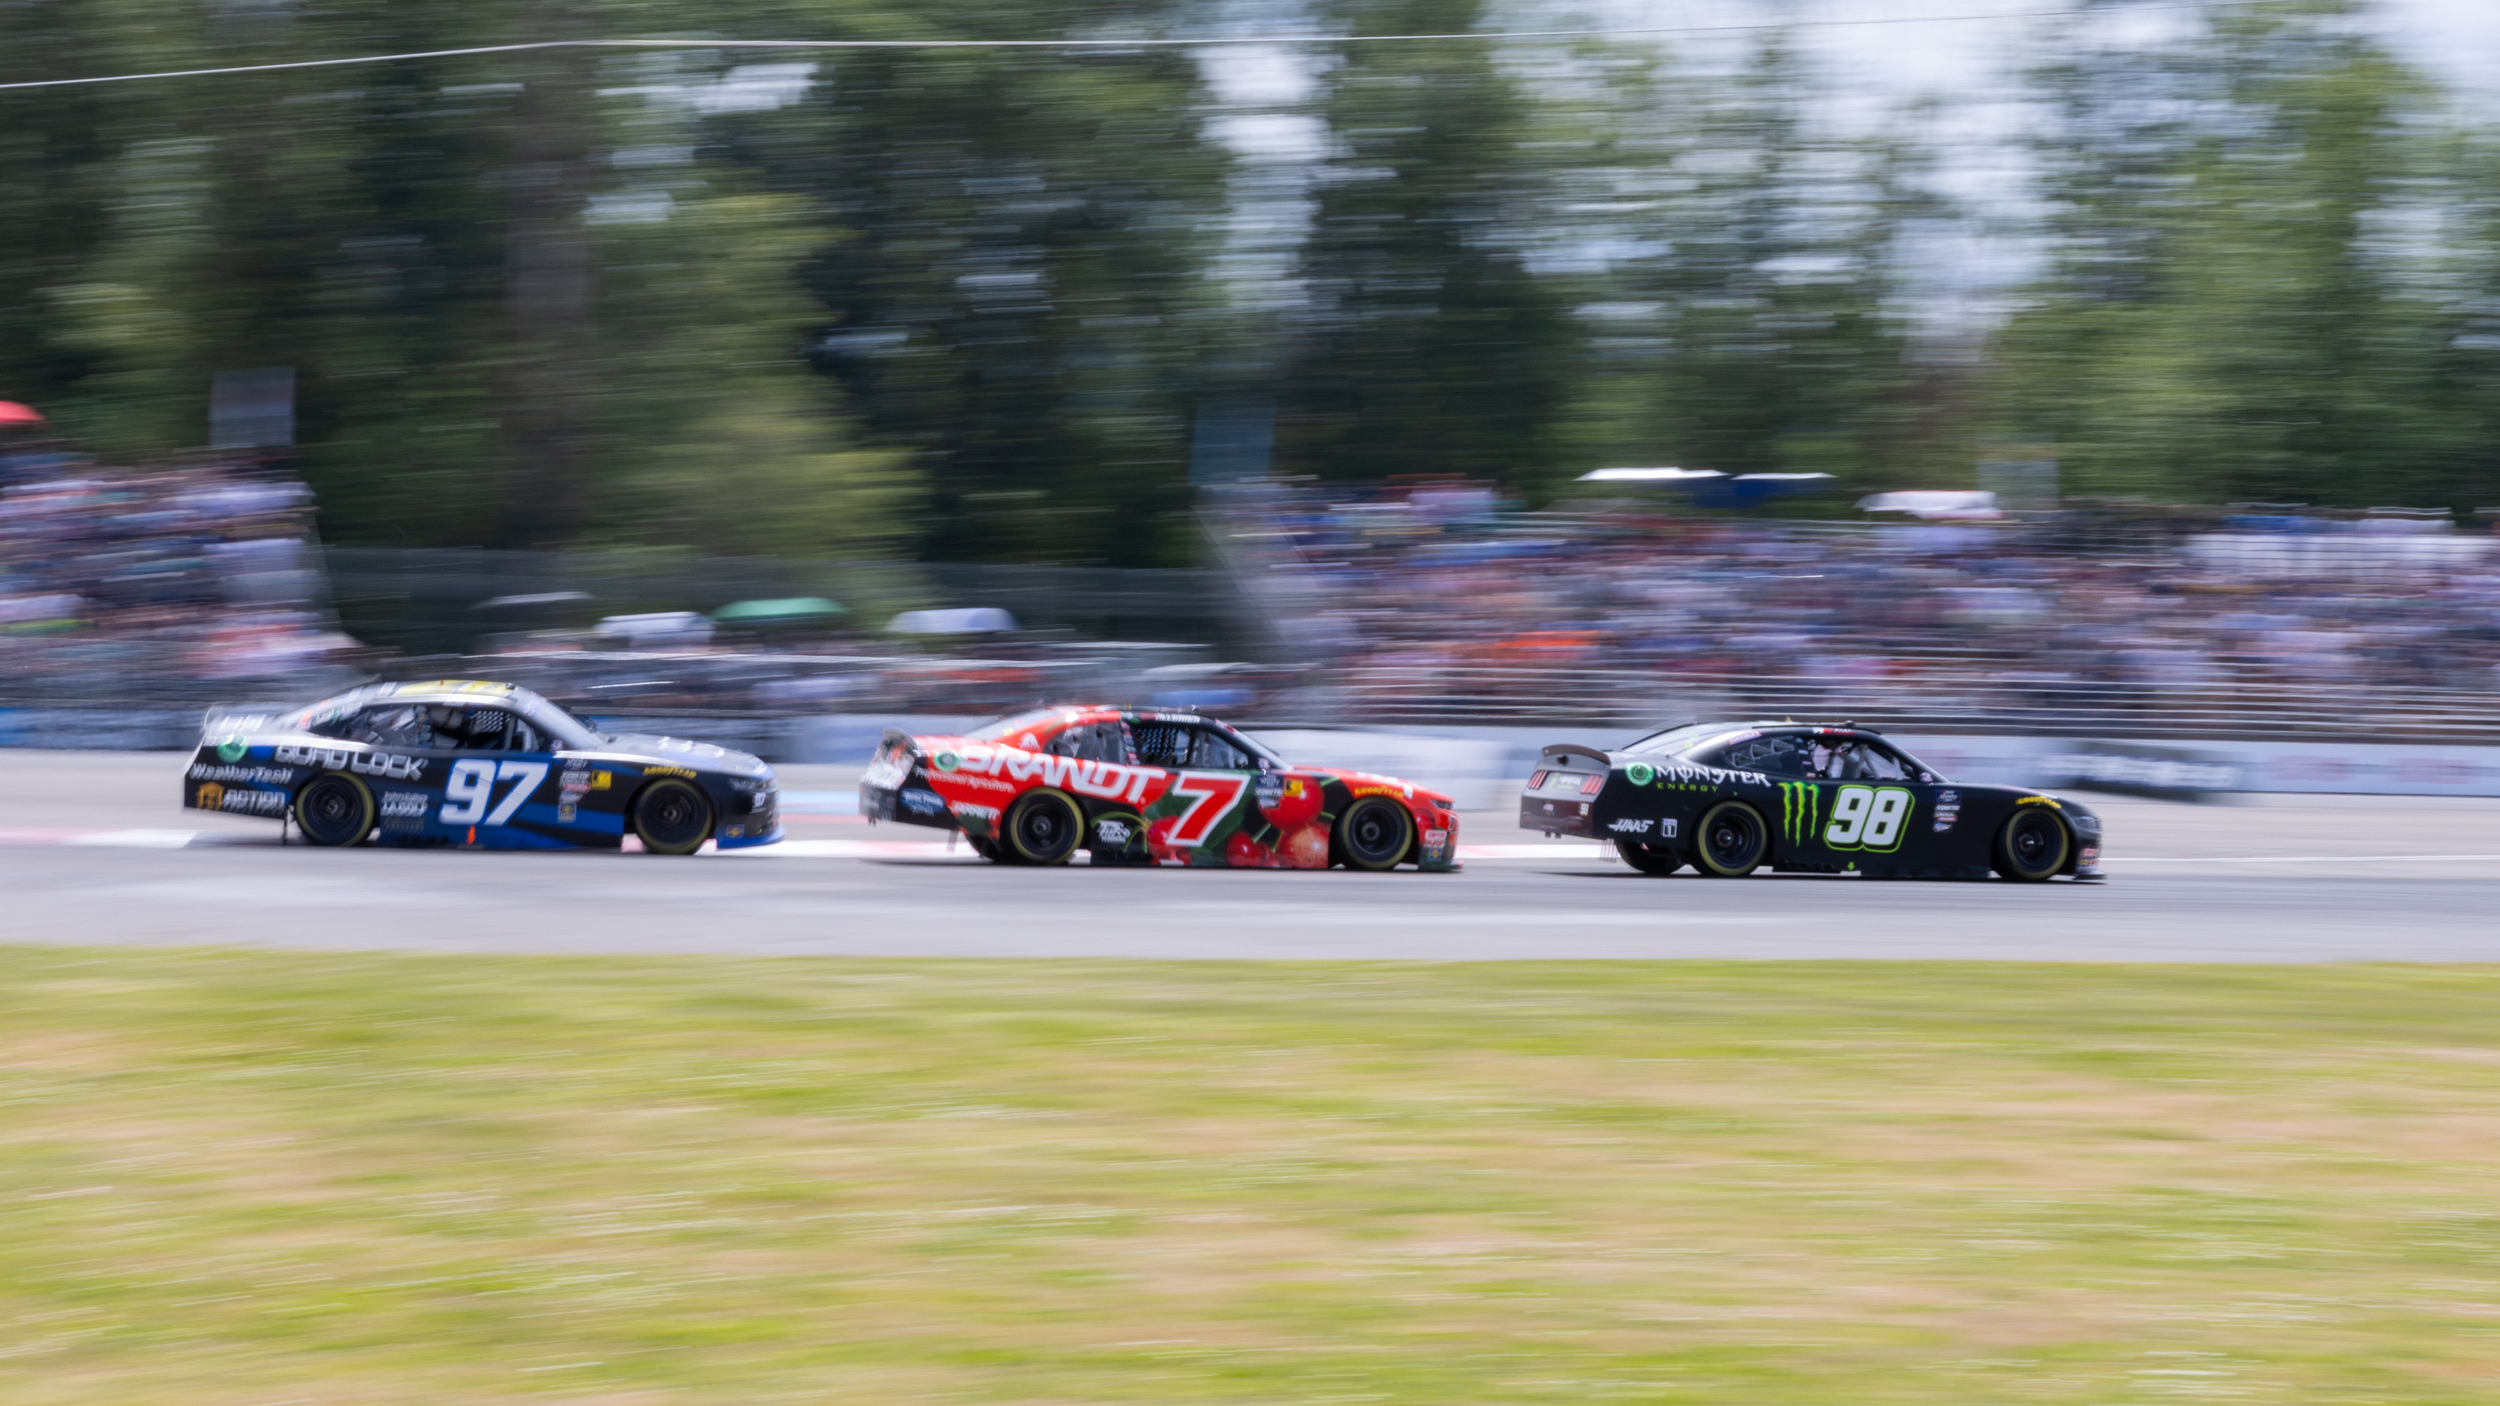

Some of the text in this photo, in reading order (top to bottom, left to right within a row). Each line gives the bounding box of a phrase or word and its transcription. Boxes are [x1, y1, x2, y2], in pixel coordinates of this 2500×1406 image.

[189, 762, 292, 785] WeatherTech
[351, 751, 422, 781] LOCK
[958, 745, 1167, 803] BRANDT
[439, 757, 550, 827] 97
[1354, 785, 1405, 799] GOODYEAR
[1656, 782, 1719, 793] ENERGY
[222, 789, 286, 814] ACTION
[1166, 769, 1251, 848] 7
[1608, 819, 1654, 833] HAAS
[1823, 784, 1915, 853] 98
